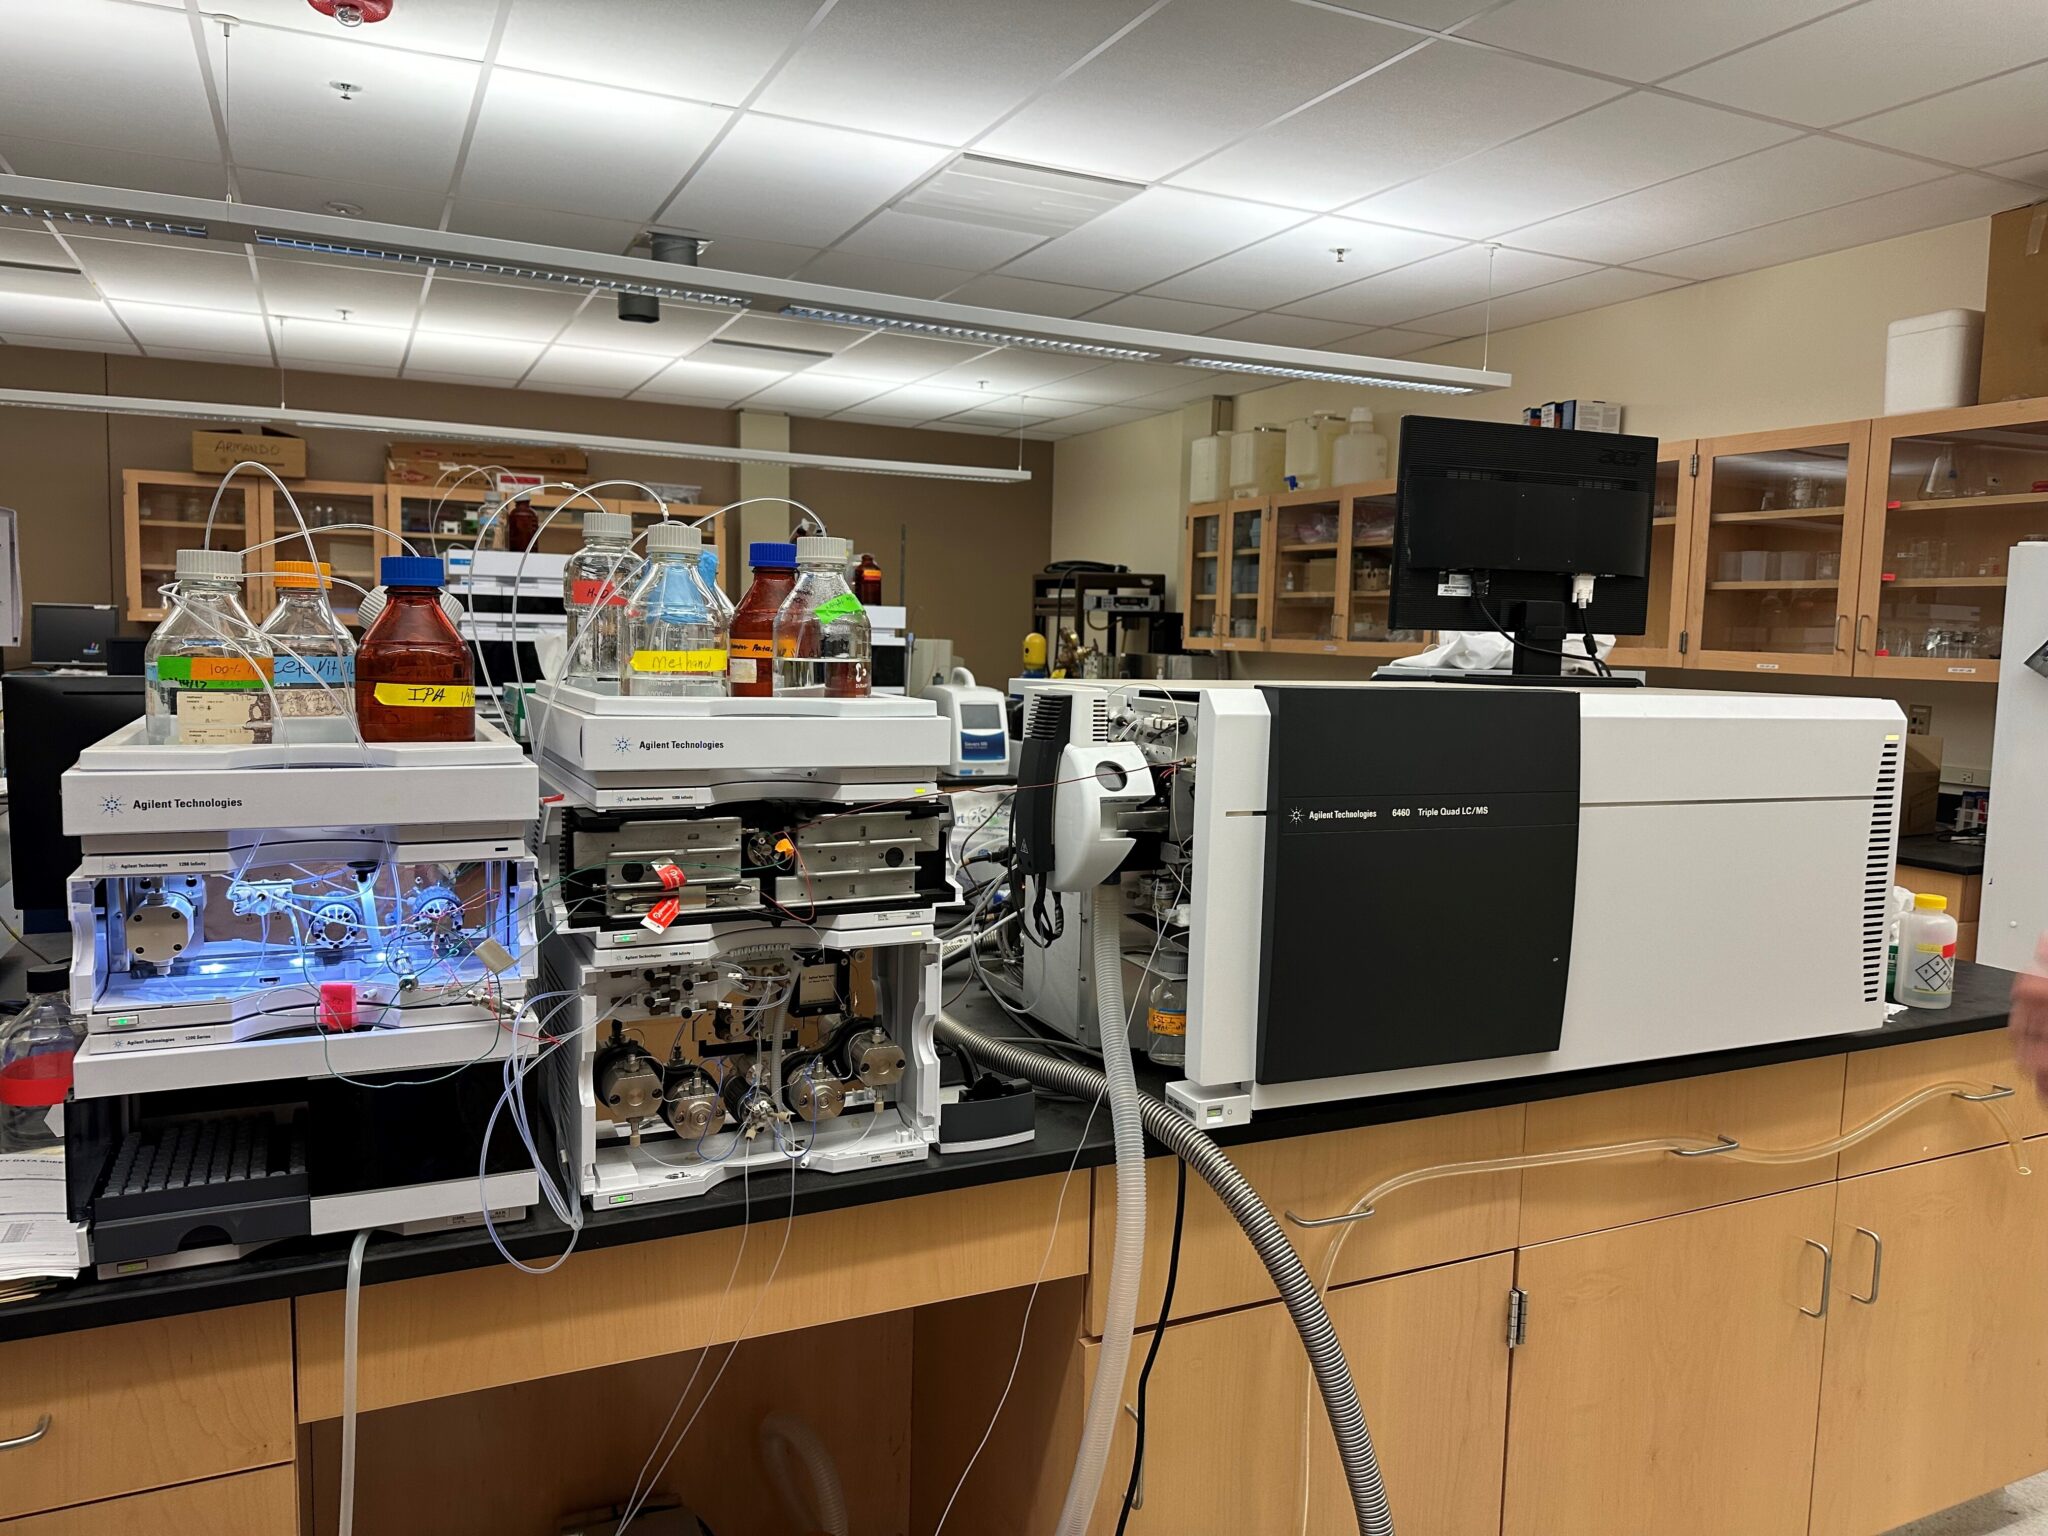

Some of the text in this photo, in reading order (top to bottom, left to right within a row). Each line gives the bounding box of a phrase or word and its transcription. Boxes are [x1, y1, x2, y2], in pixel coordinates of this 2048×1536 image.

[408, 686, 446, 703] IPA
[638, 740, 724, 751] Agilent Technologies
[132, 798, 243, 811] Agilent Technologies
[1309, 806, 1489, 821] Agilent Technologies 6460 Triple Quad LC/MS
